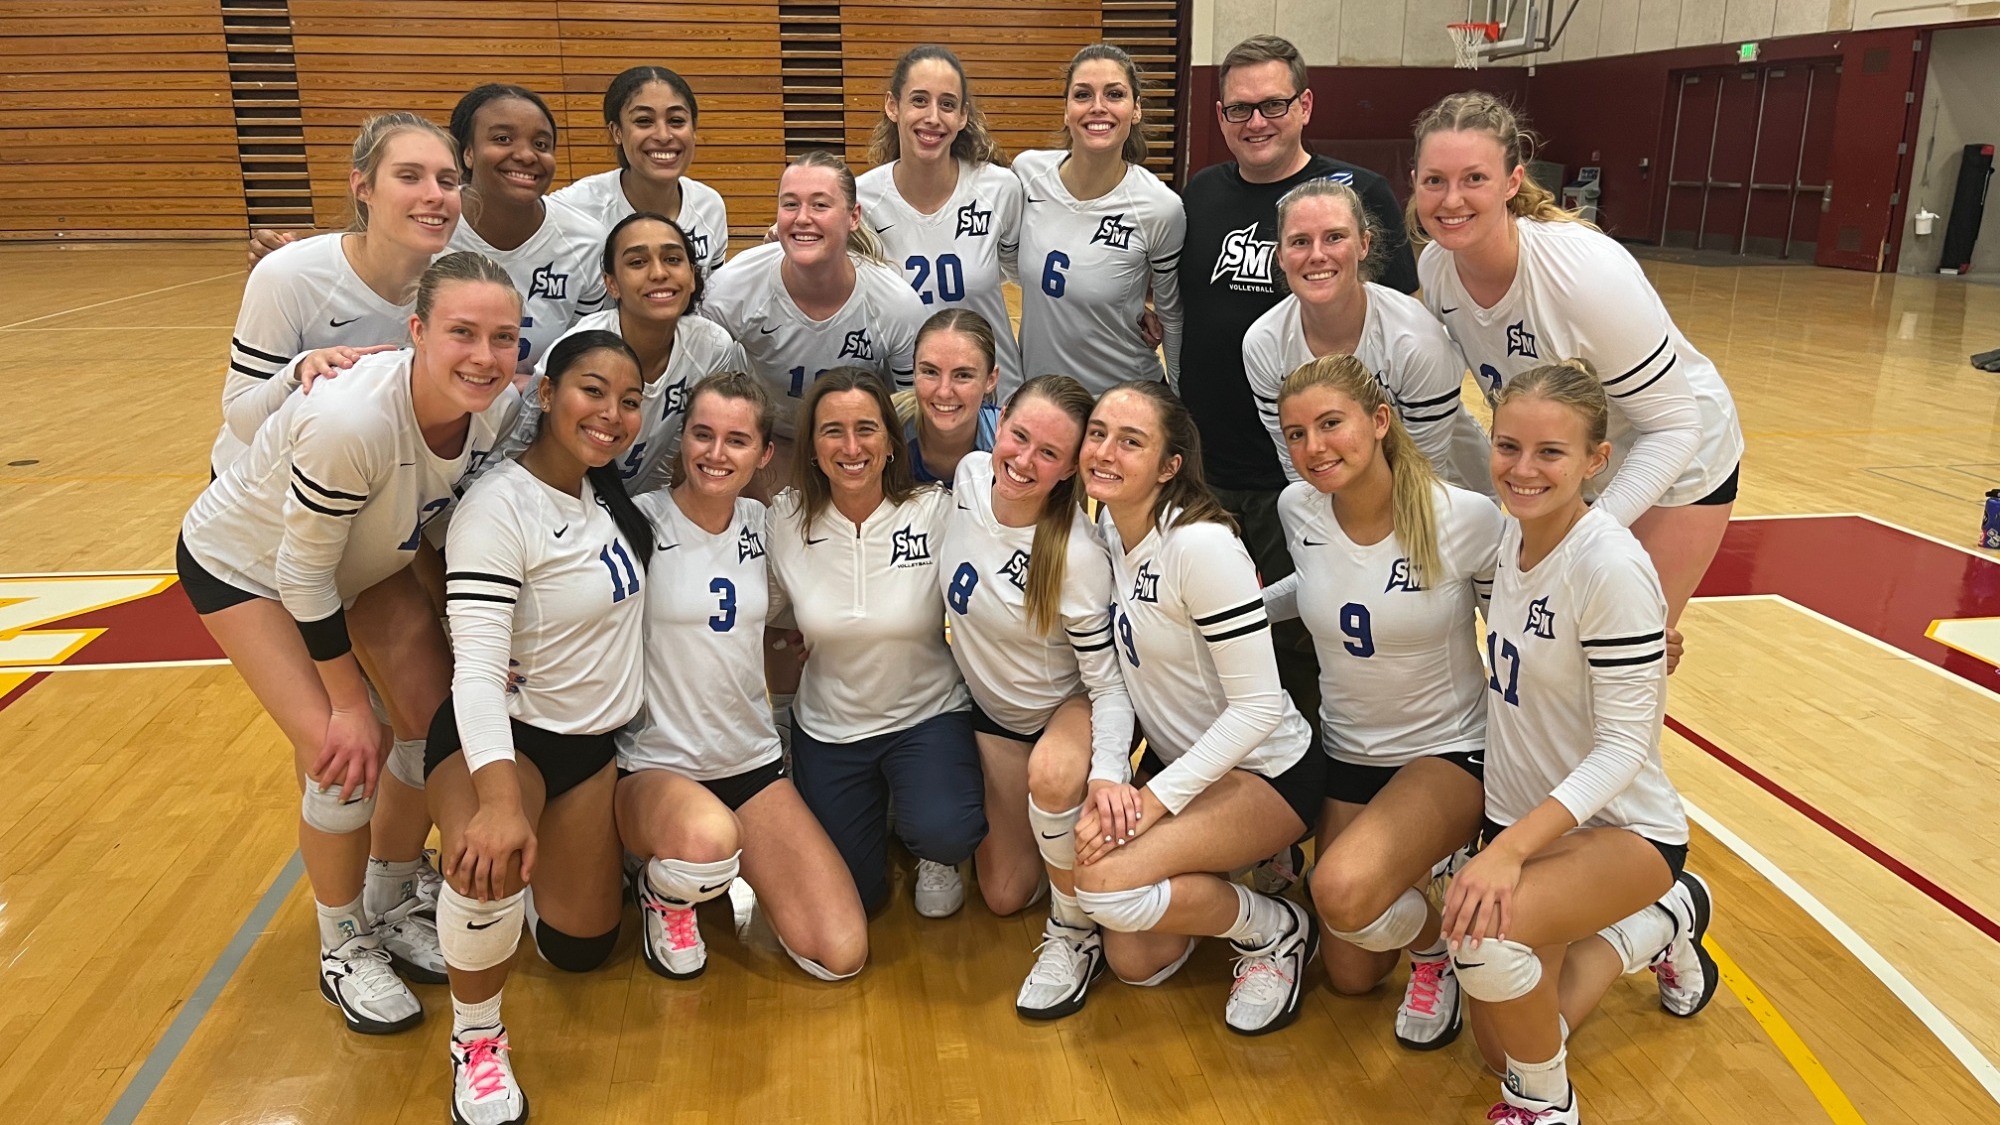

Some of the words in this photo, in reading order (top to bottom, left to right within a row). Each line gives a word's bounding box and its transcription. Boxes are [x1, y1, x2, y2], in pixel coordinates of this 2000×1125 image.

[956, 202, 991, 238] SM
[1092, 215, 1134, 249] SM
[1041, 250, 1071, 299] 6
[1214, 225, 1275, 284] SM
[530, 264, 568, 300] SM
[905, 253, 965, 304] 20
[1229, 284, 1274, 293] VOLLEYBALL
[840, 329, 874, 360] SM
[1507, 322, 1538, 359] SM
[738, 527, 765, 562] SM
[891, 526, 930, 565] SM
[600, 537, 640, 603] 11
[948, 562, 979, 615] 8
[1131, 561, 1160, 603] SM
[709, 577, 737, 632] 3
[1524, 597, 1555, 639] SM
[1340, 602, 1375, 658] 9
[1487, 631, 1520, 707] 17
